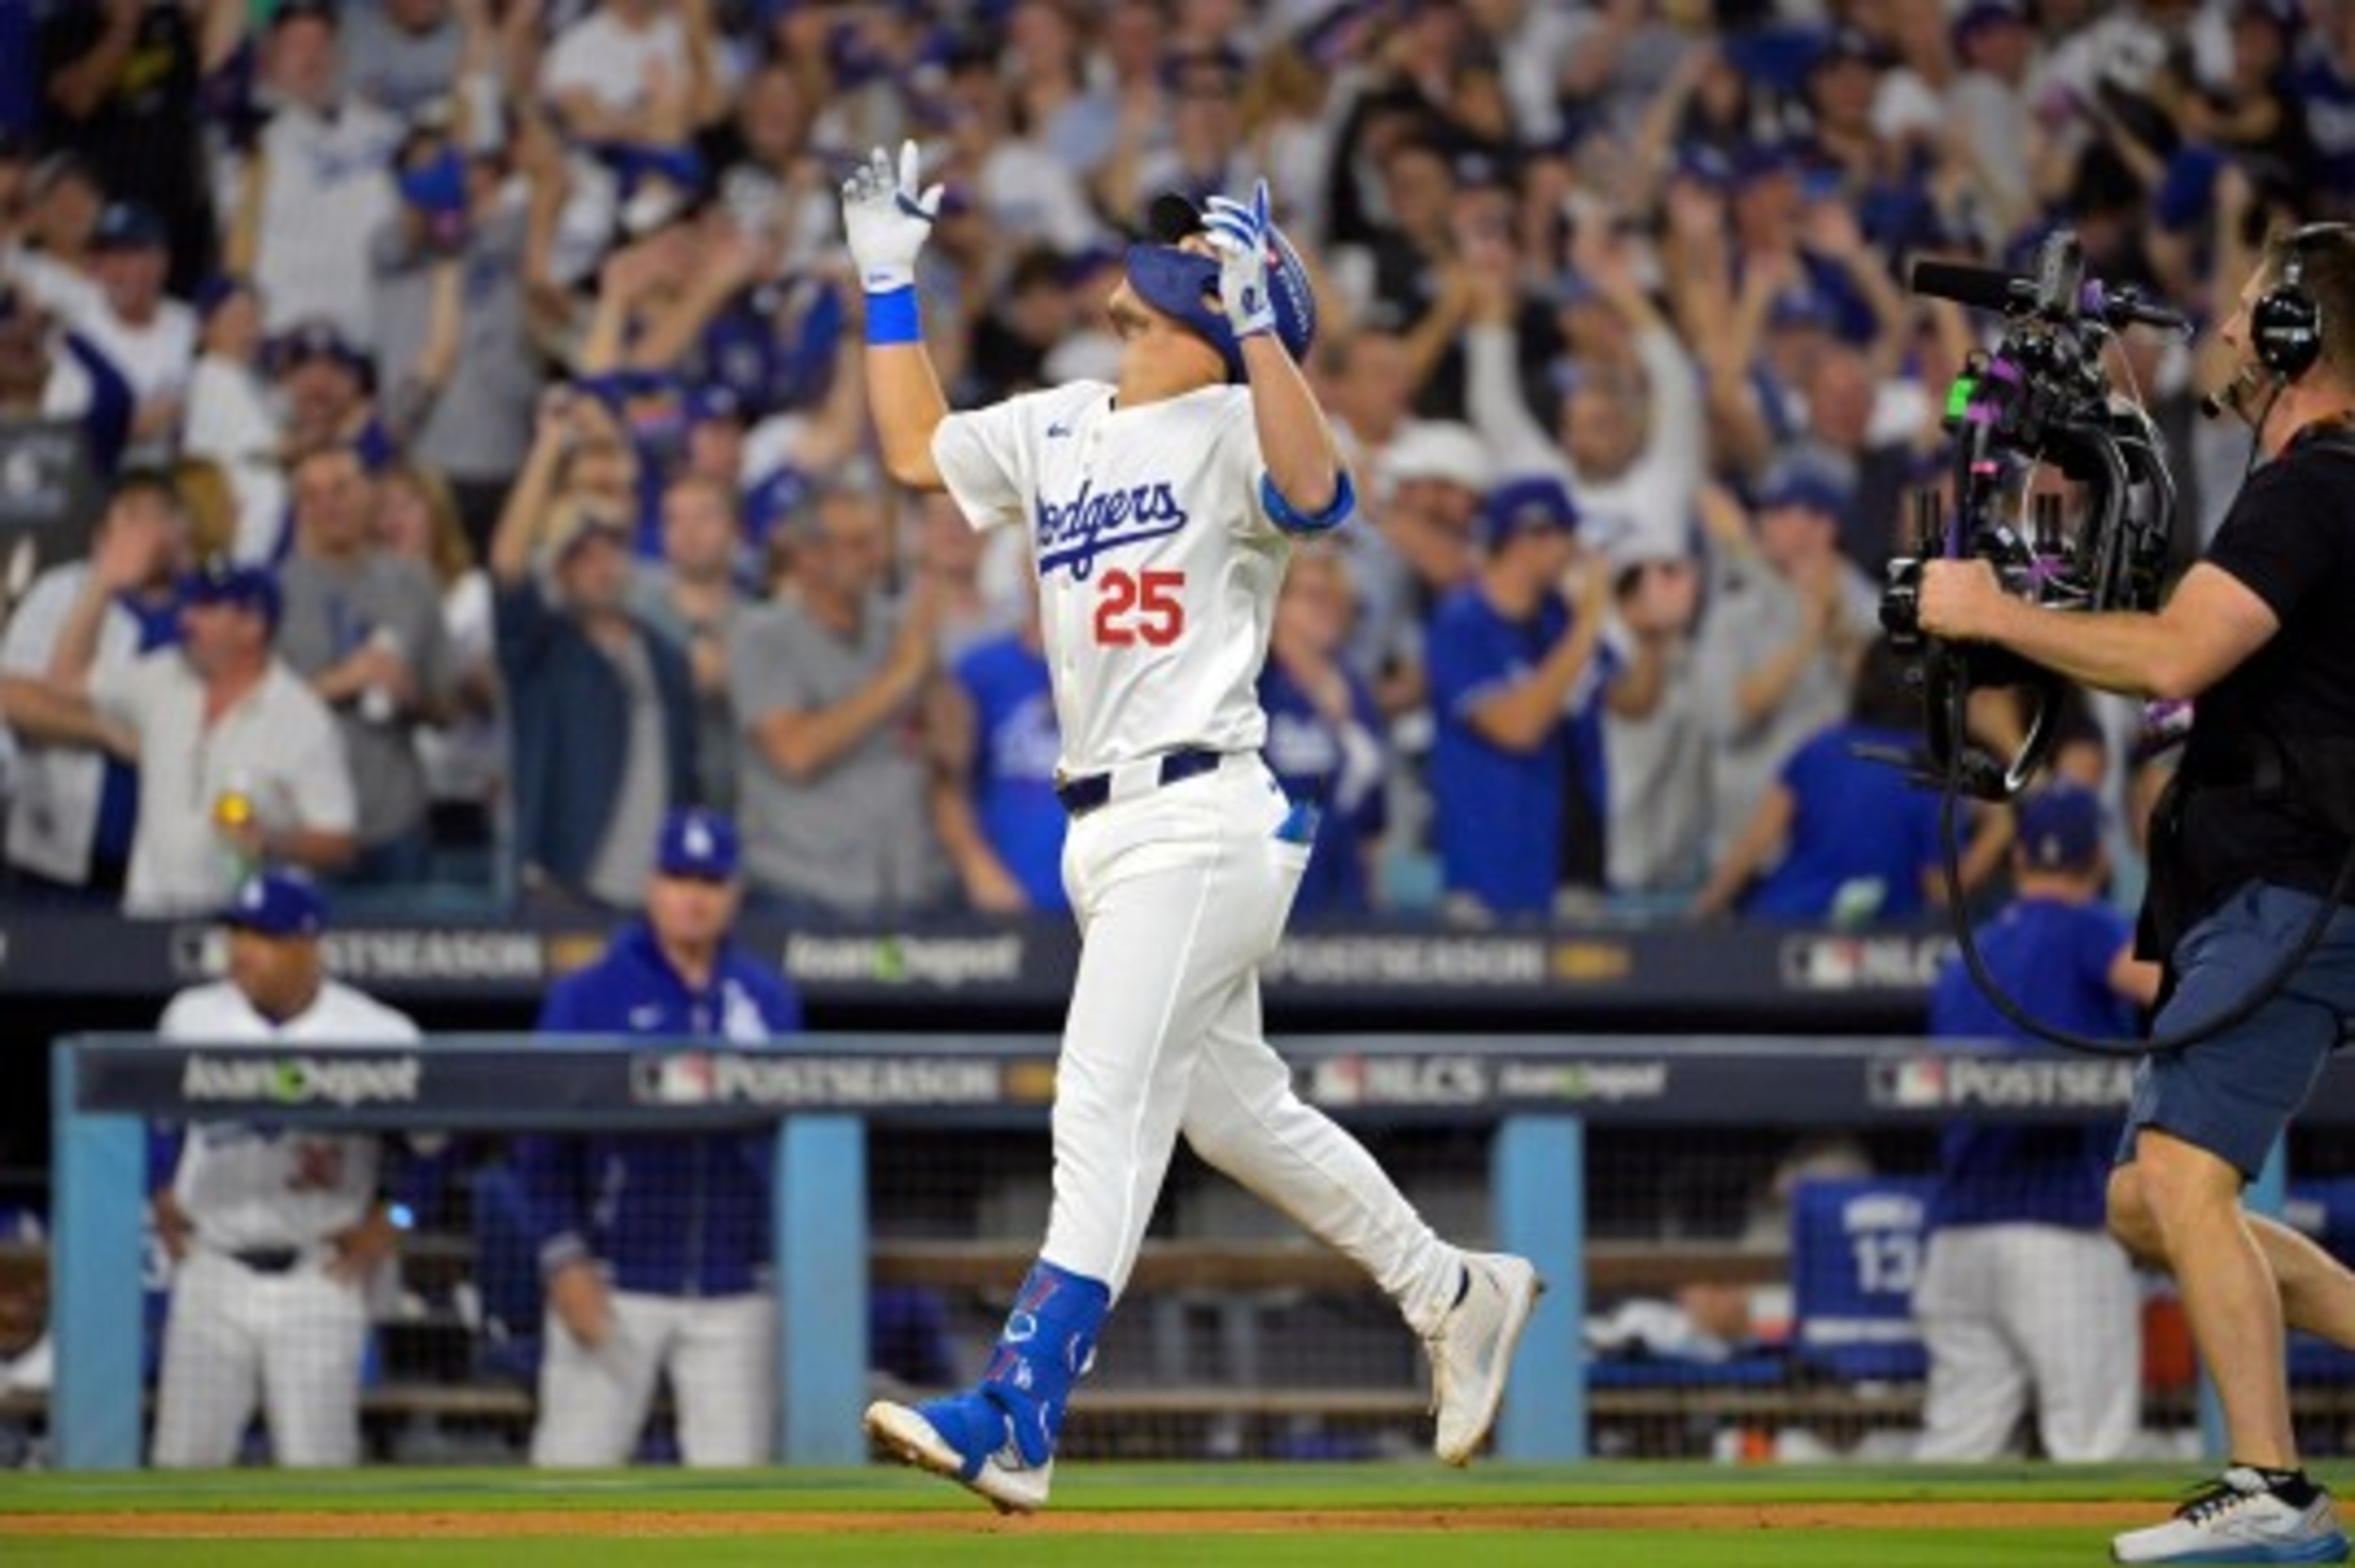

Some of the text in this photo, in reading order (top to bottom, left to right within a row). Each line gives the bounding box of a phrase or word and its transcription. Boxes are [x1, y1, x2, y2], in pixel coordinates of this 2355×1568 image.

[1036, 479, 1188, 581] odgers
[1096, 568, 1185, 647] 25
[321, 930, 544, 980] STSEASON
[1865, 937, 1963, 985] NLC
[717, 1057, 998, 1104] POSTSEASON
[1368, 1057, 1487, 1104] NLCS
[1951, 1059, 2133, 1105] POSTSEA
[1853, 1234, 1918, 1294] 13
